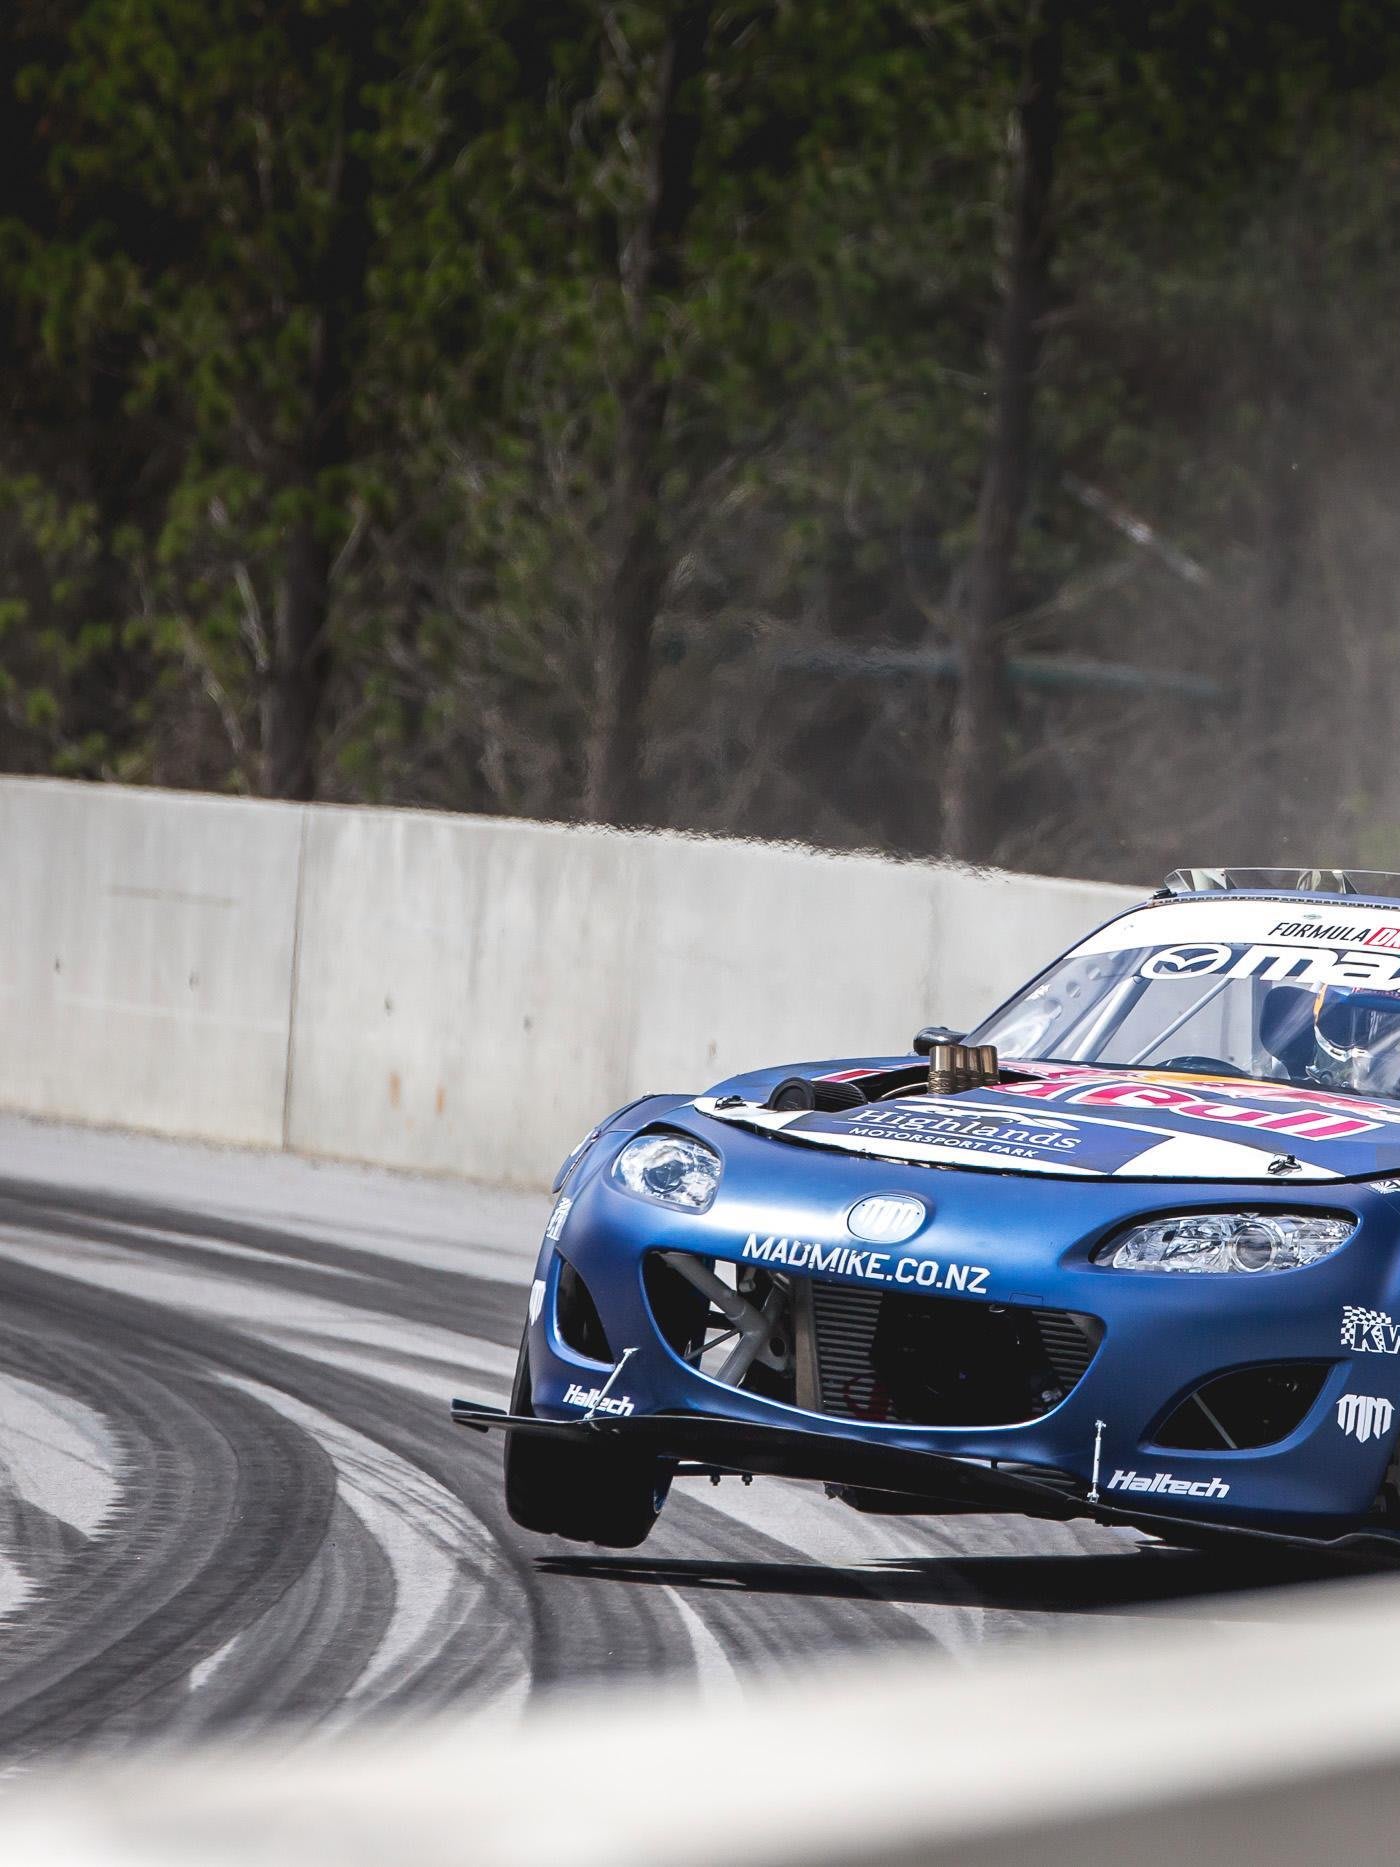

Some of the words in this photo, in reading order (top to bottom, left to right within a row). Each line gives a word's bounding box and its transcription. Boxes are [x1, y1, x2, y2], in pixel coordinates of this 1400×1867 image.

[1268, 922, 1371, 942] FORMULA
[847, 1109, 1082, 1149] Highlands
[848, 1127, 987, 1150] MOTORSPORT
[987, 1144, 1039, 1159] PARK
[742, 1233, 991, 1294] MADMIKE.CO.NZ
[1107, 1469, 1231, 1498] Haltech
